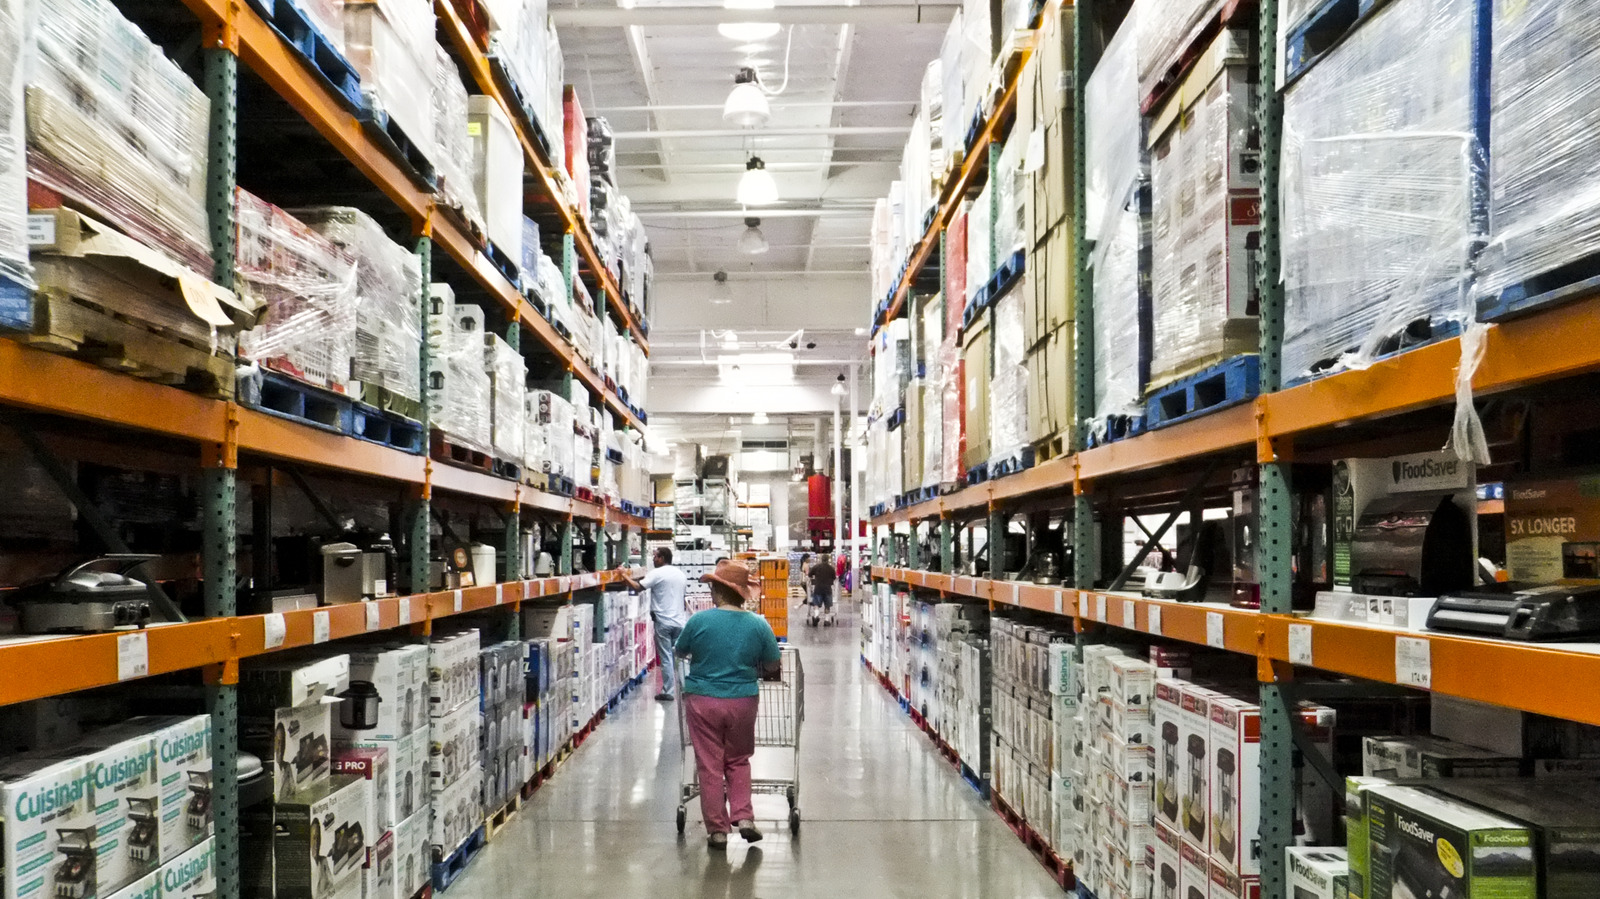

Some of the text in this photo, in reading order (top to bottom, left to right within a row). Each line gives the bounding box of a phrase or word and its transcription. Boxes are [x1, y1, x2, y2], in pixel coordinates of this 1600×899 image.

[1402, 459, 1458, 481] FoodSaver
[1528, 516, 1577, 534] LONGER
[1059, 650, 1068, 693] Cuisinart
[160, 727, 211, 763] Cuisinart
[95, 749, 157, 789] Cuisinart
[345, 761, 366, 770] PRO
[15, 770, 95, 822] Cuisinart
[1398, 815, 1434, 844] FoodSaver
[164, 845, 216, 893] Cuisinart
